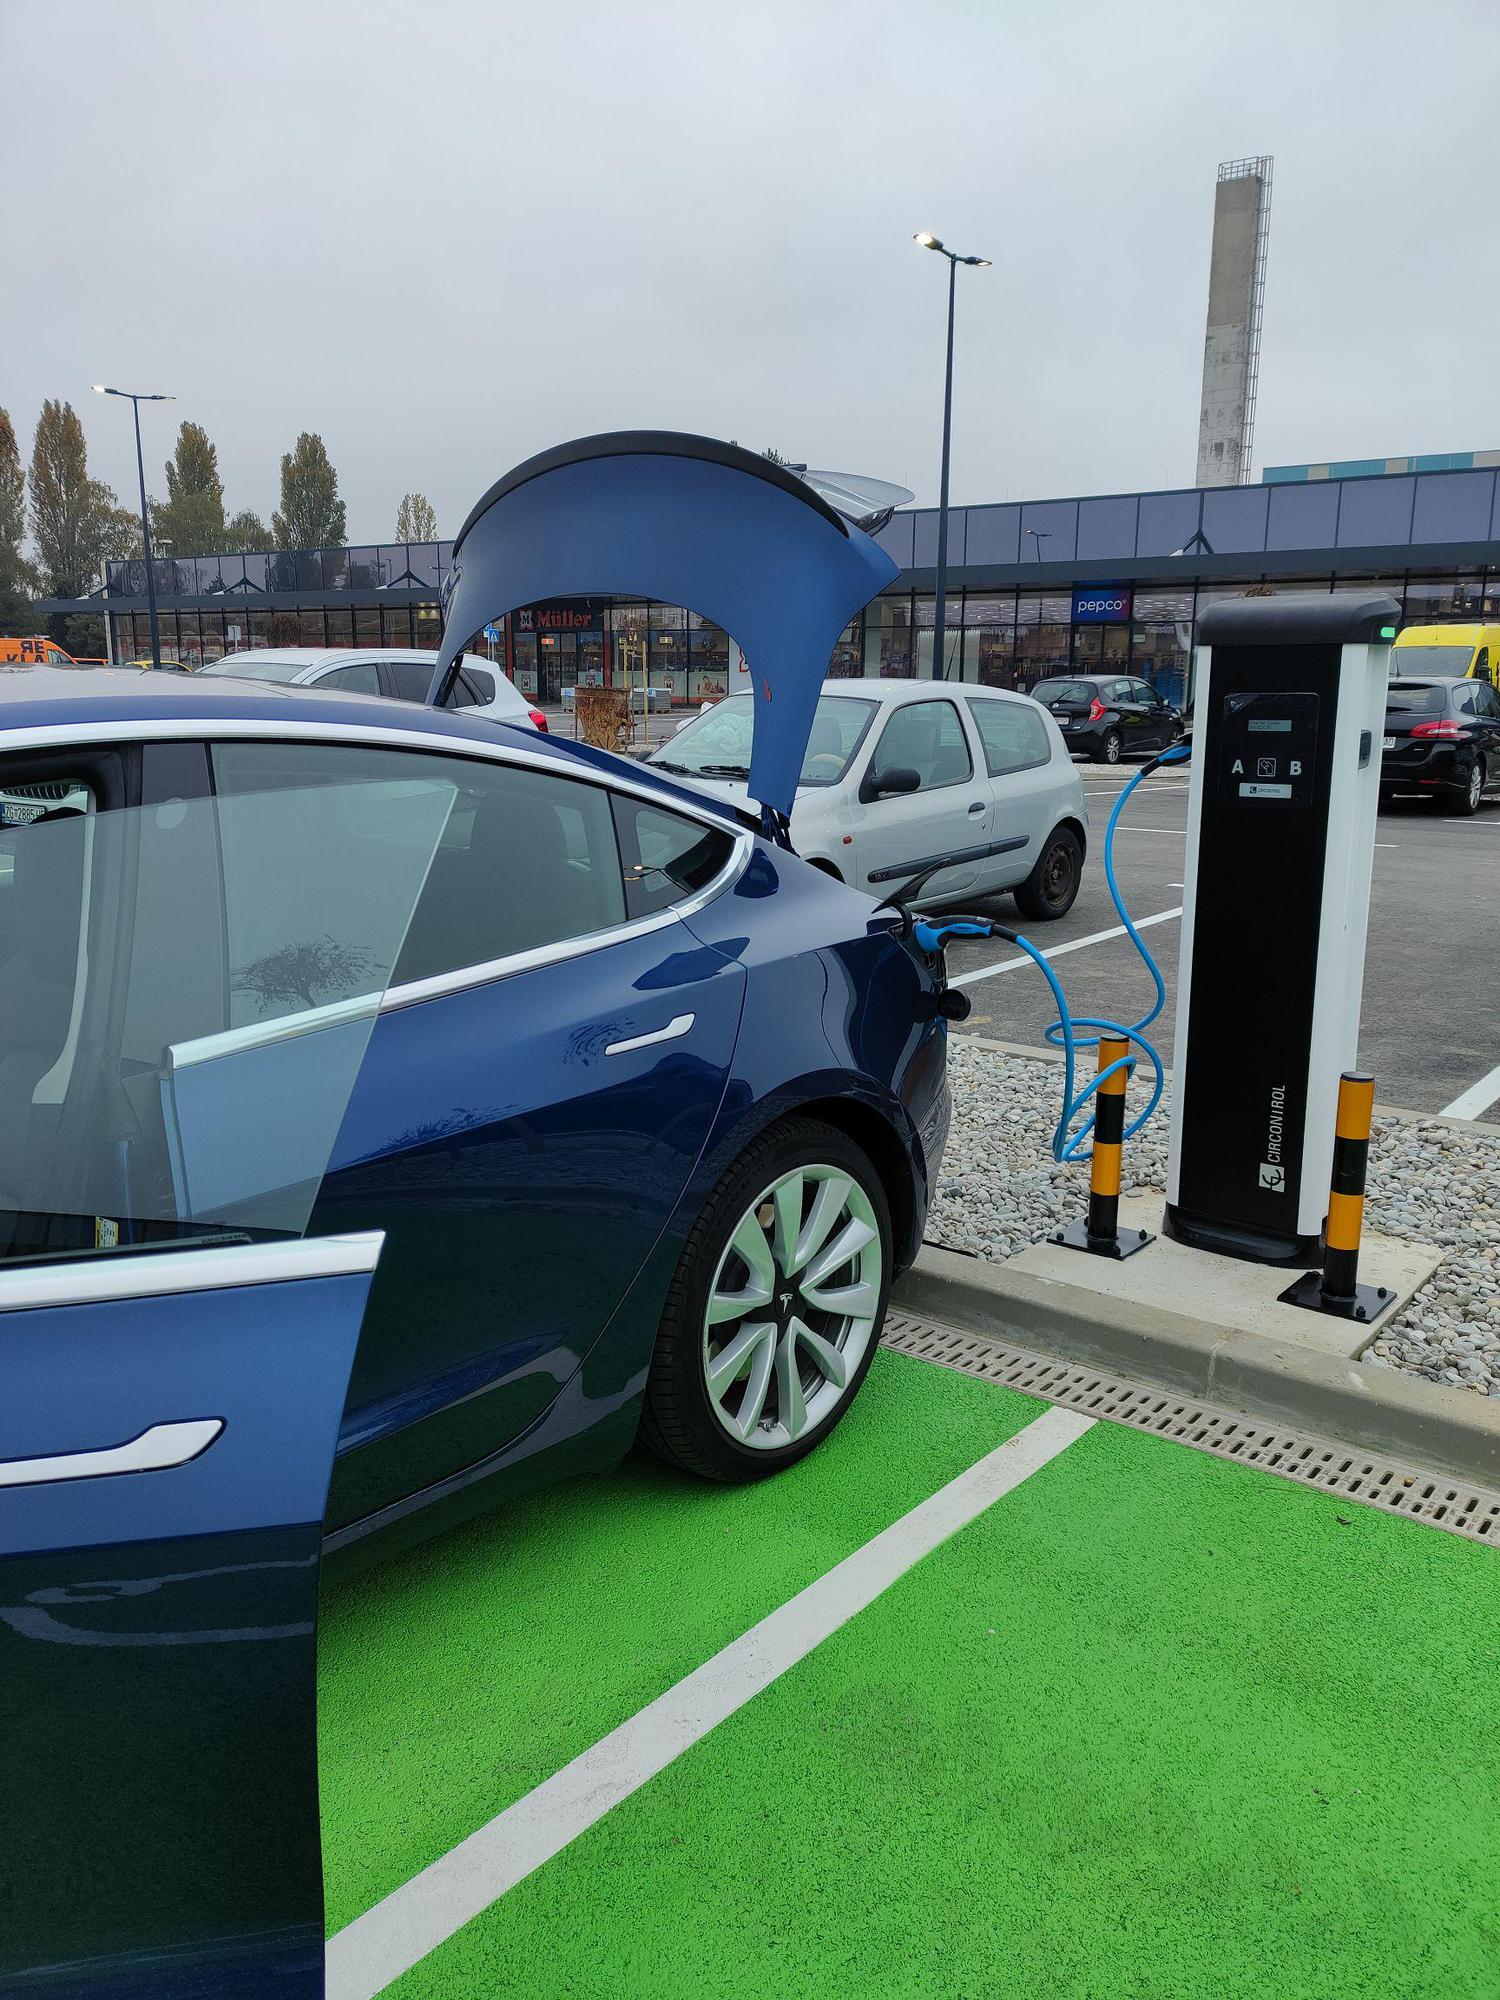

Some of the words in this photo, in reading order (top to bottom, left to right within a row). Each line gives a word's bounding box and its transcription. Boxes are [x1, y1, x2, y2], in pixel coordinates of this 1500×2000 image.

[1077, 600, 1123, 613] pepco
[536, 608, 592, 628] Müller
[1231, 759, 1244, 774] A
[1289, 760, 1302, 776] B
